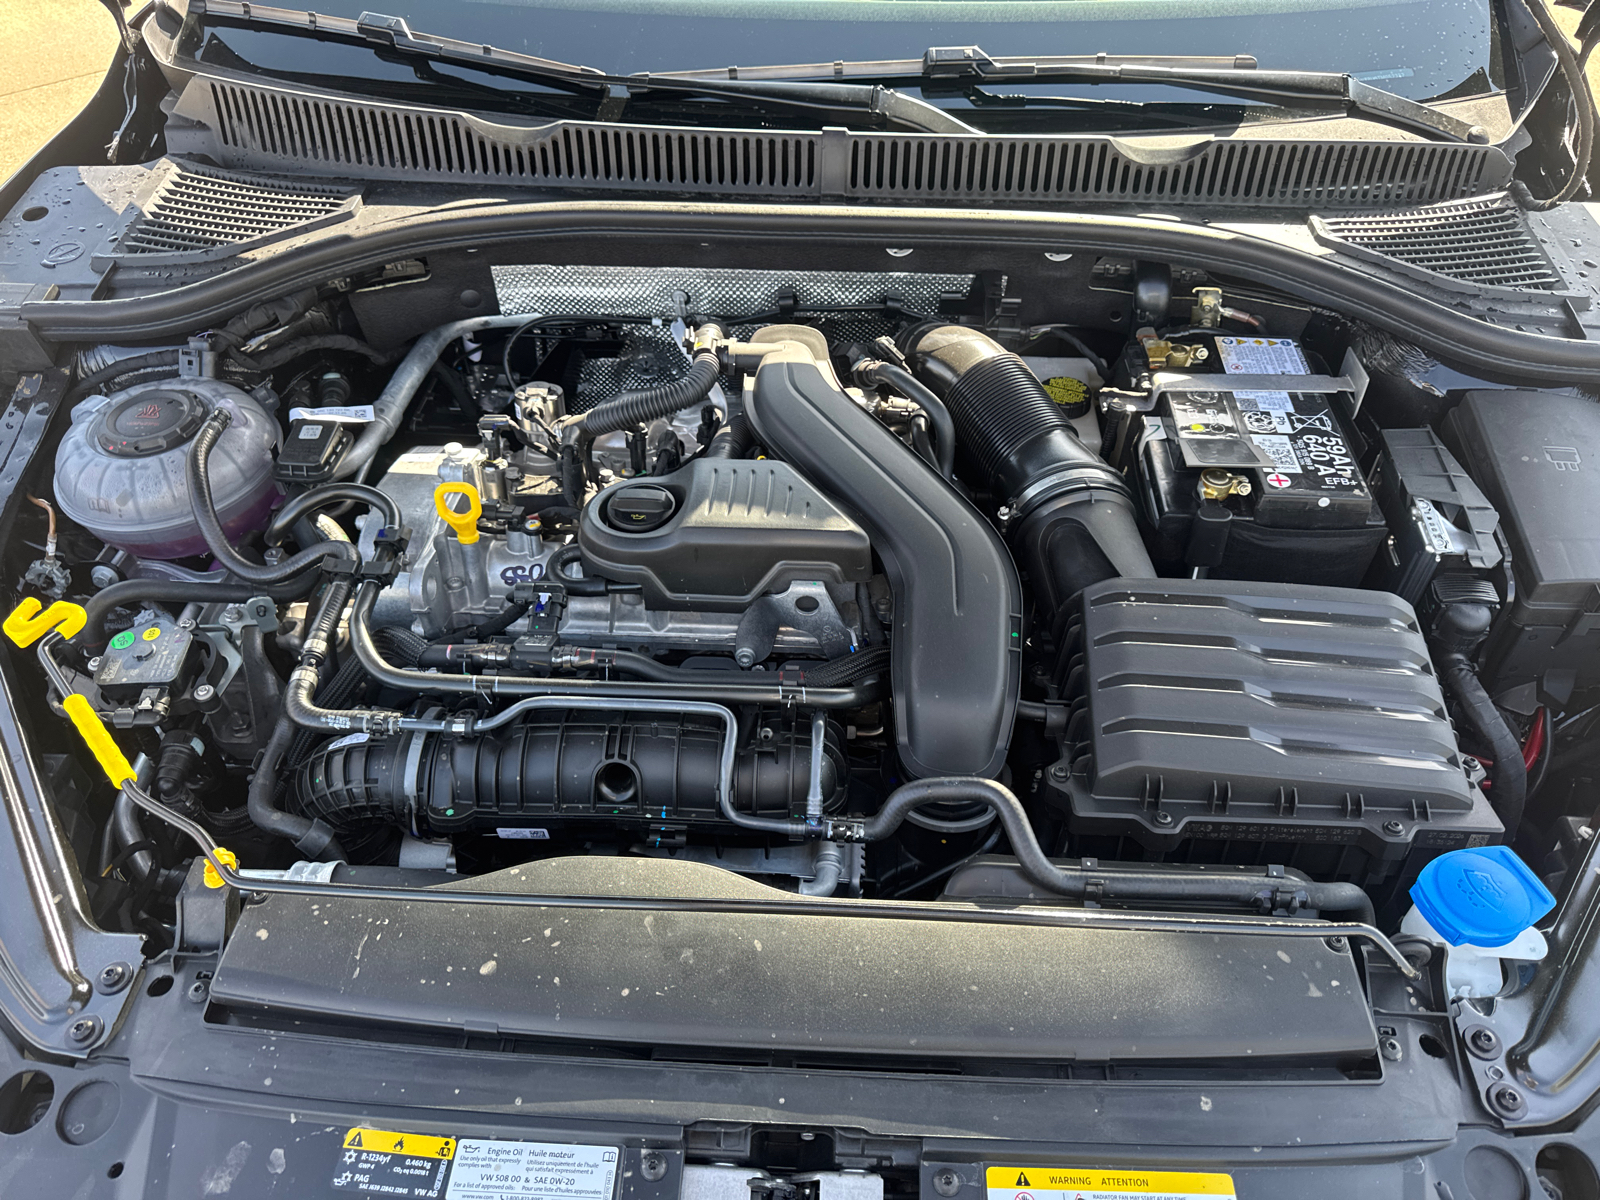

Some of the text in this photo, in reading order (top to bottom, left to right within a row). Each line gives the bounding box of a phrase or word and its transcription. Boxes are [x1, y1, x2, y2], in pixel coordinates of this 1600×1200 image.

[1303, 435, 1330, 460] 640
[1322, 437, 1354, 474] 59Ah
[1314, 464, 1336, 475] A
[1325, 477, 1358, 485] EFB+
[488, 1148, 511, 1156] Engine
[361, 1153, 391, 1164] R-1234yf
[424, 1160, 432, 1169] kg
[354, 1174, 370, 1182] PAG
[1049, 1176, 1148, 1187] WARNING ATTENTION
